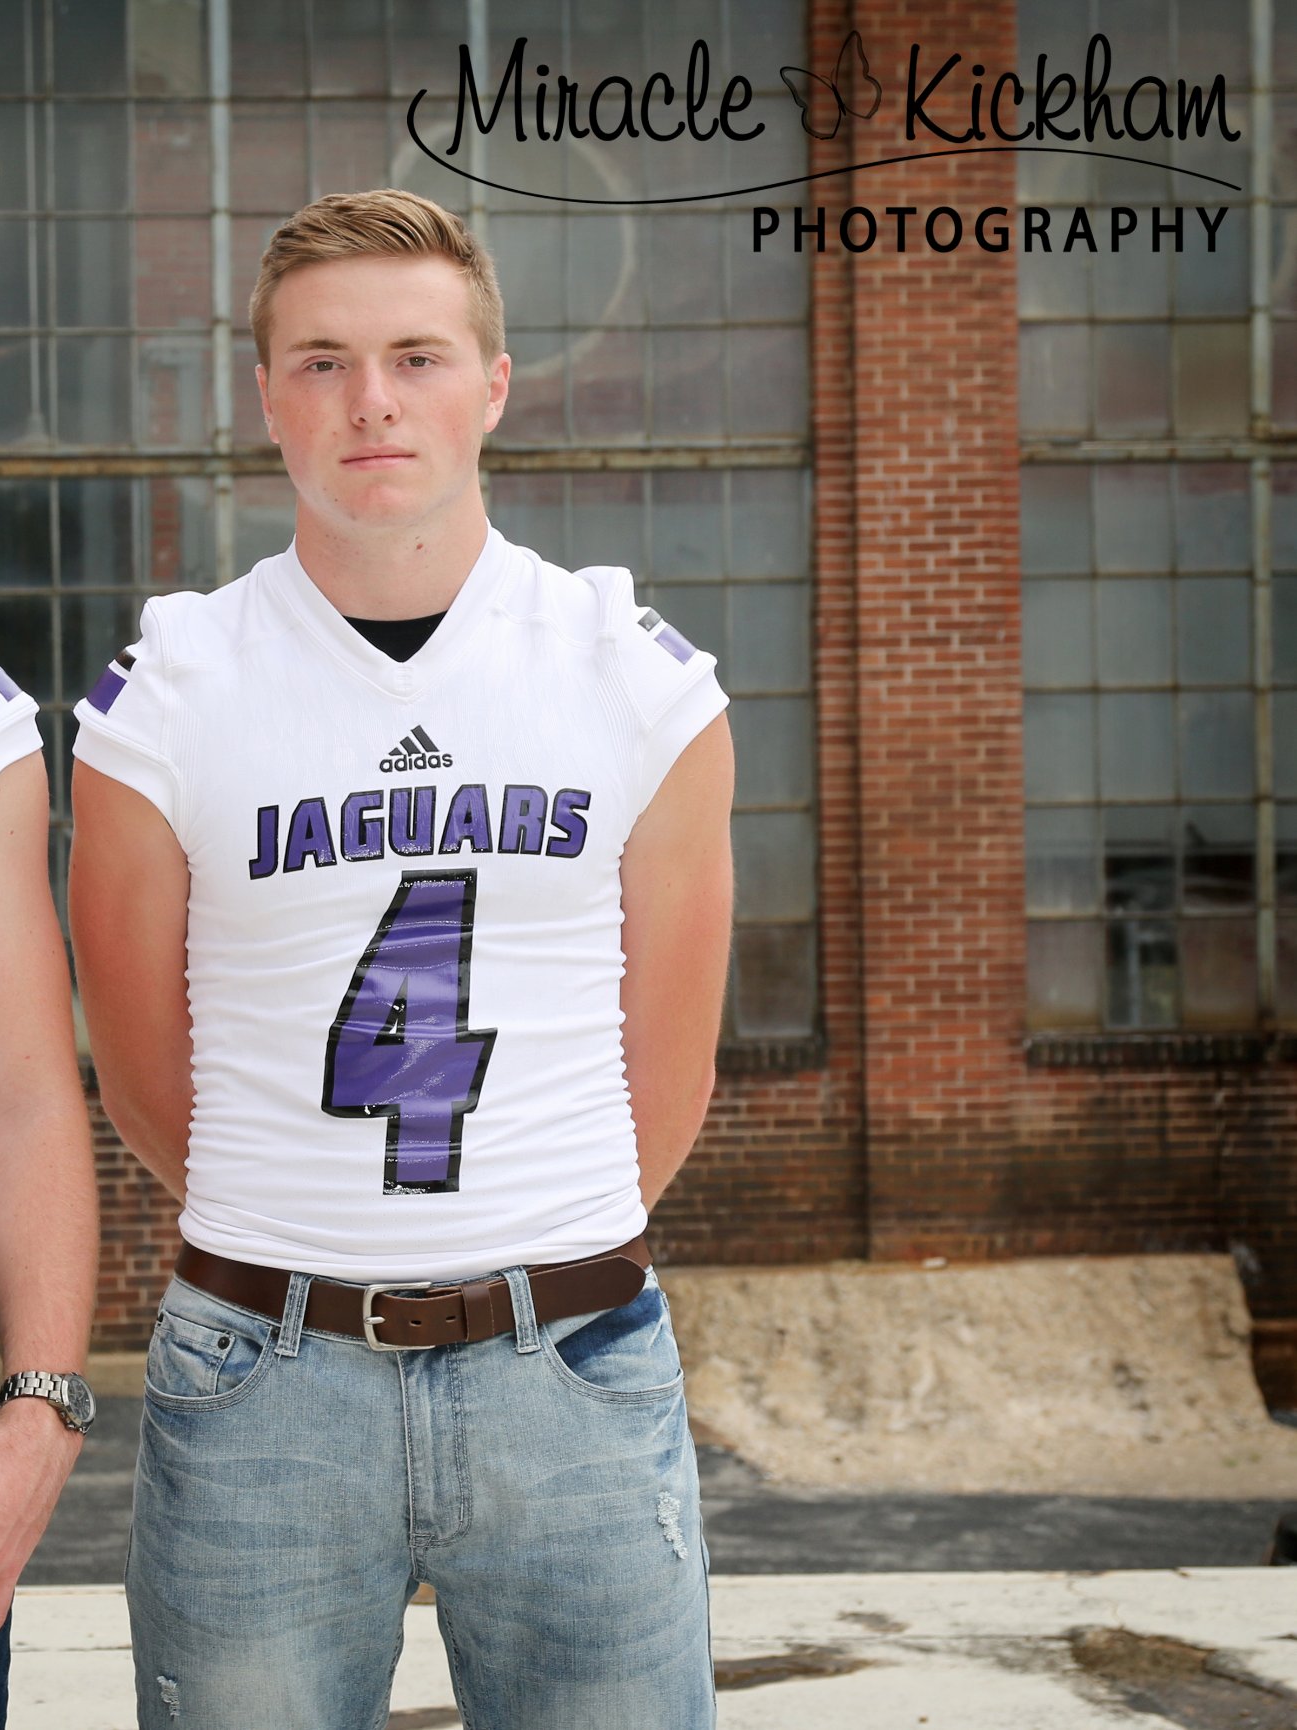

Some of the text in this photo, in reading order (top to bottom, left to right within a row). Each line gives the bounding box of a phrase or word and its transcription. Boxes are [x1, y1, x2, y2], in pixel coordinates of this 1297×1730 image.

[379, 750, 454, 773] adidas
[248, 784, 592, 880] JAGUARS
[321, 867, 499, 1196] 4
